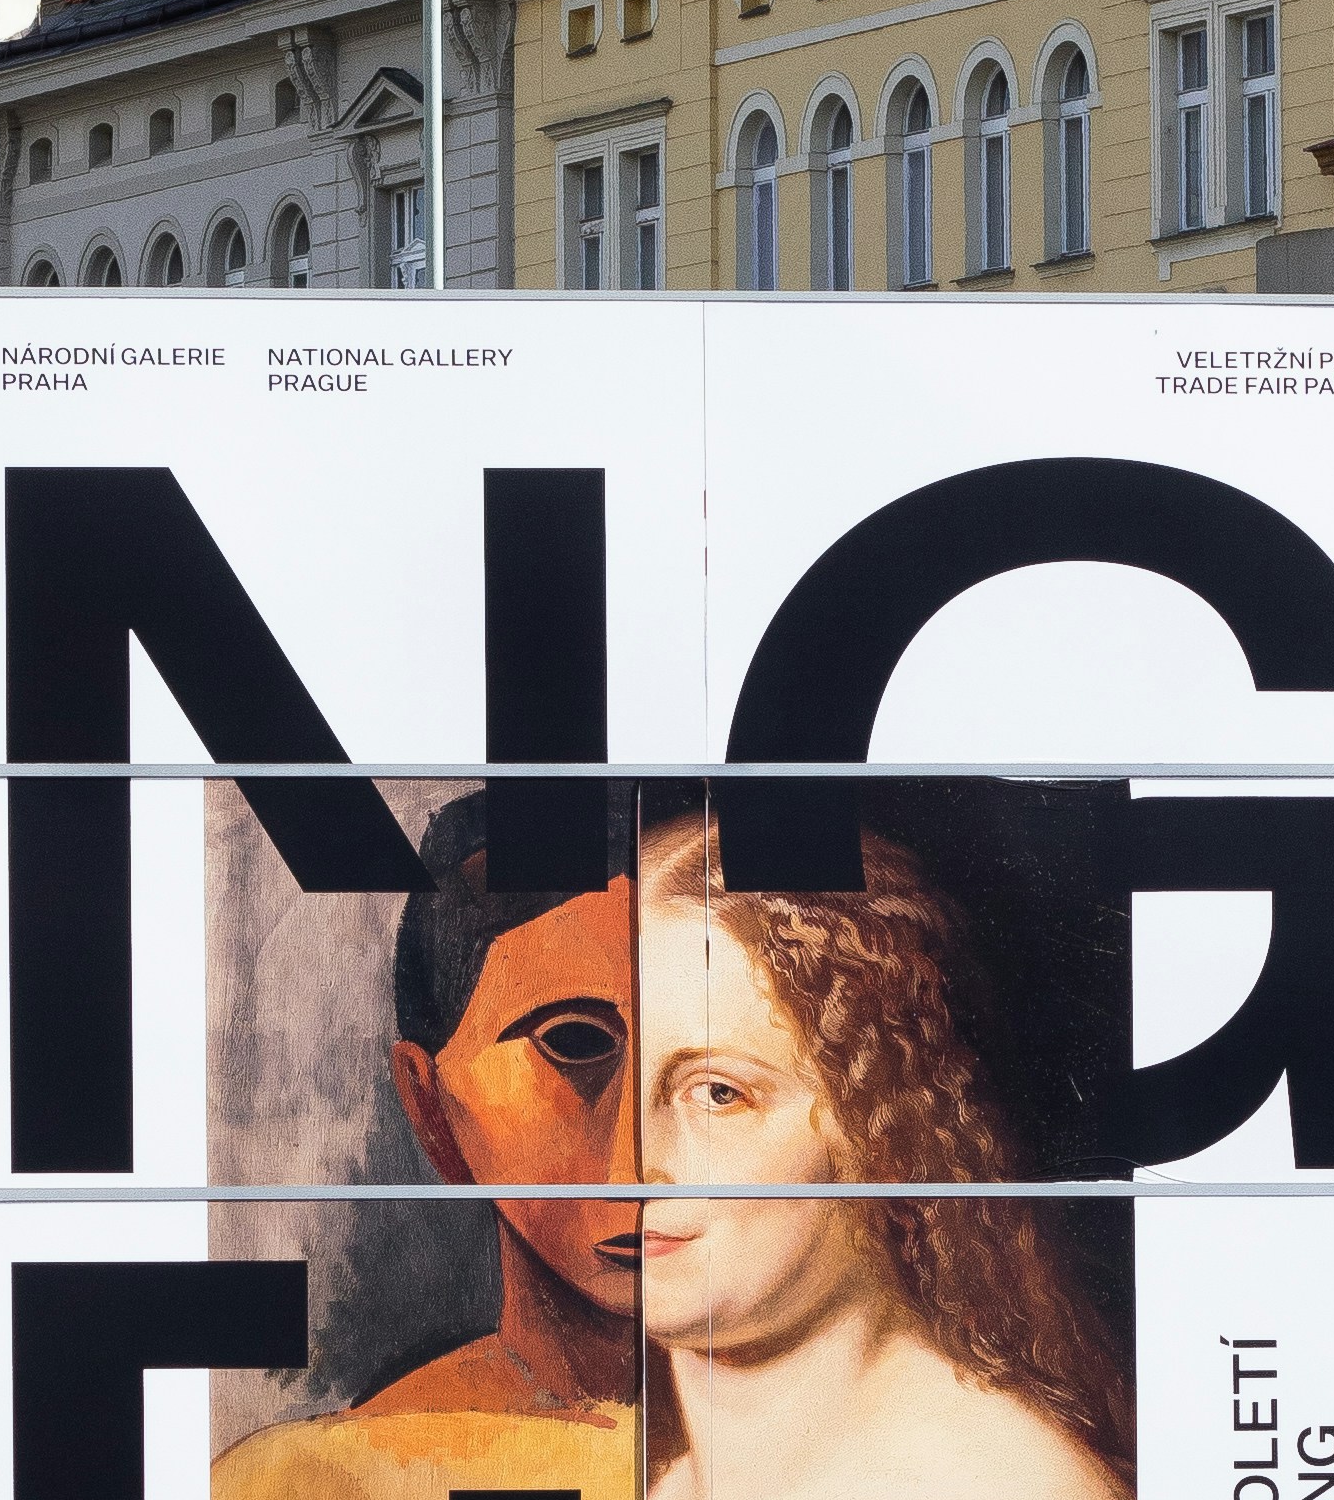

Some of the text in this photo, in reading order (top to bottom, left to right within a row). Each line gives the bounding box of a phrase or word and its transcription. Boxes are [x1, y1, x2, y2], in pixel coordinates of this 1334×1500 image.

[3, 342, 225, 366] NÁRODNÍ GALERIE
[269, 348, 513, 367] NATIONAL GALLERY
[1176, 346, 1313, 369] VELETRŽNÍ
[2, 373, 88, 391] PRAHA
[268, 374, 367, 392] PRAGUE
[1156, 376, 1238, 395] TRADE
[1245, 376, 1297, 395] FAIR
